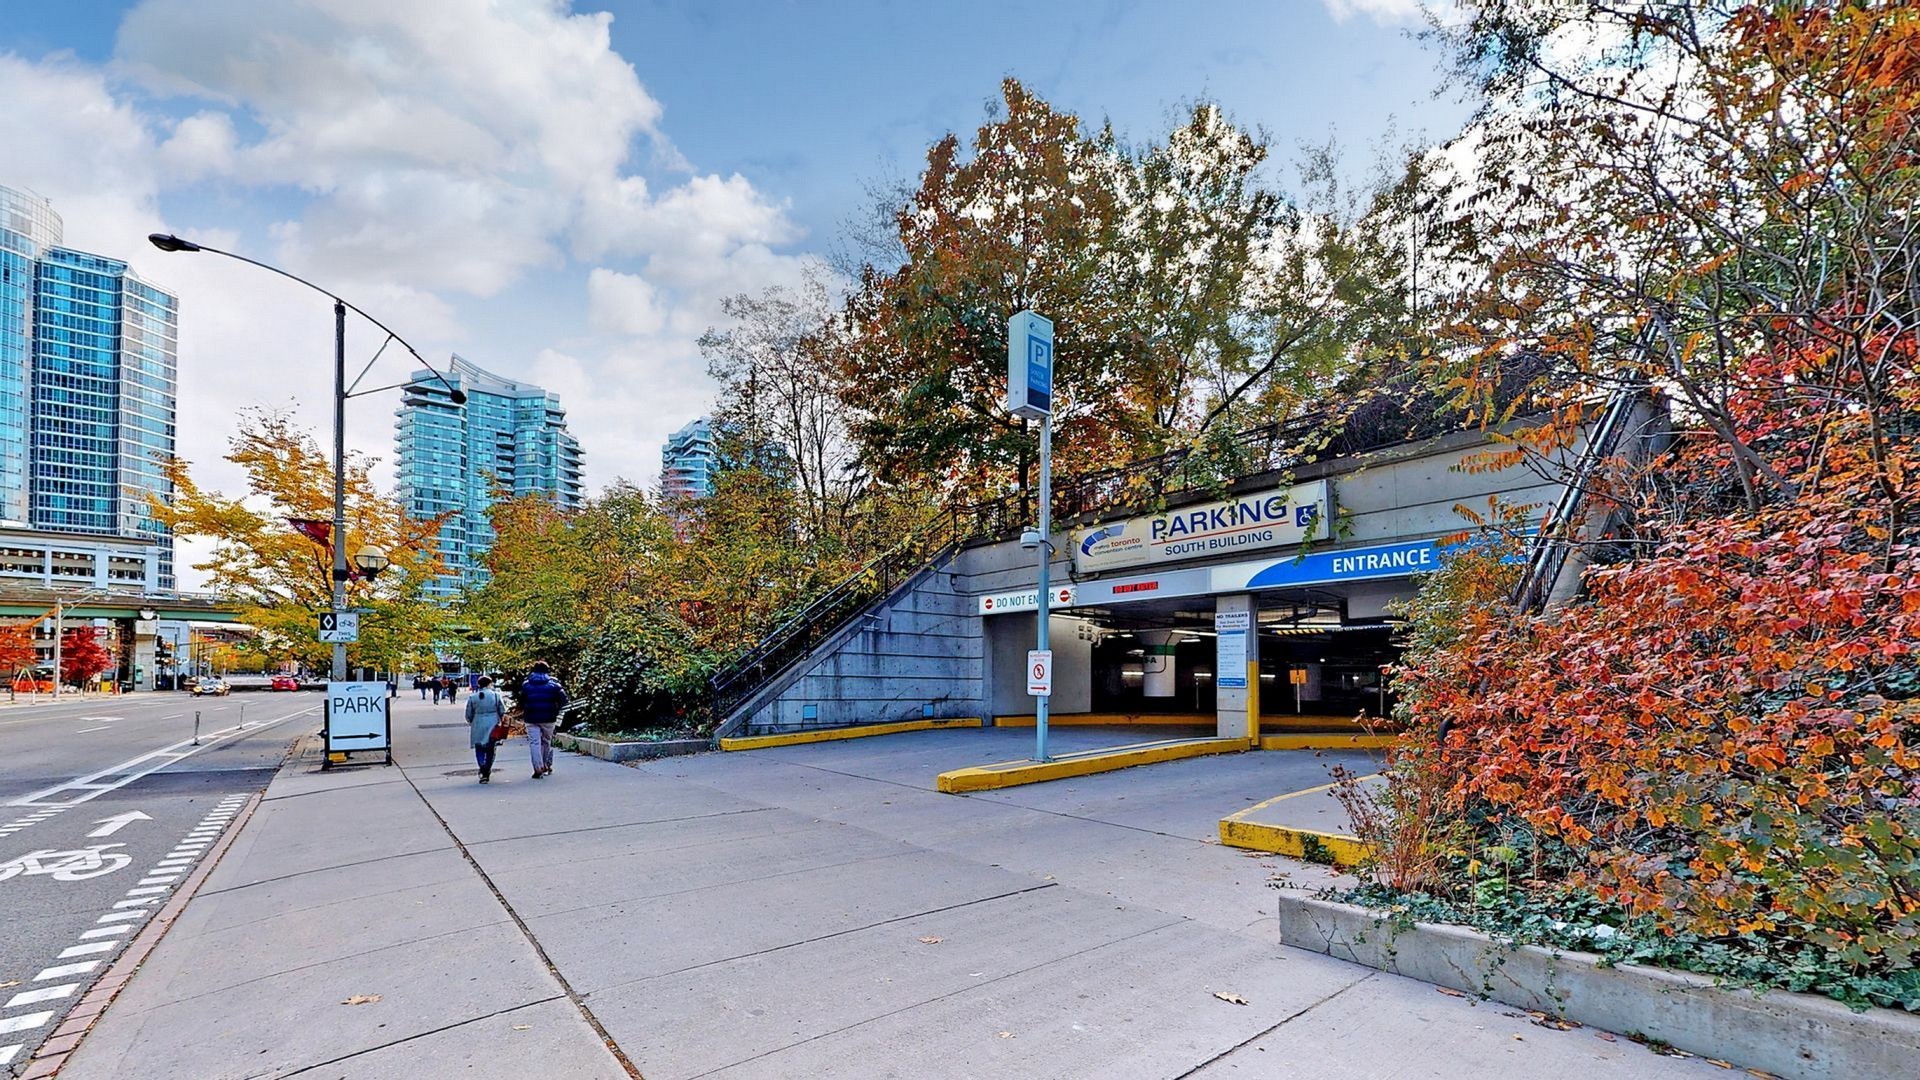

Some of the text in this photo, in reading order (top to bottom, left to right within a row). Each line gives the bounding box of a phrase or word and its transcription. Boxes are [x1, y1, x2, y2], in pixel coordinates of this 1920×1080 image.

[1035, 344, 1044, 362] P
[1152, 495, 1288, 540] PARKING
[1094, 543, 1143, 556] convention centre
[1110, 537, 1141, 548] toronto
[1165, 530, 1273, 556] SOUTH BUILDING
[1332, 548, 1431, 574] ENTRANCE
[996, 592, 1055, 608] DO NOT ENR
[333, 695, 382, 714] PARK
